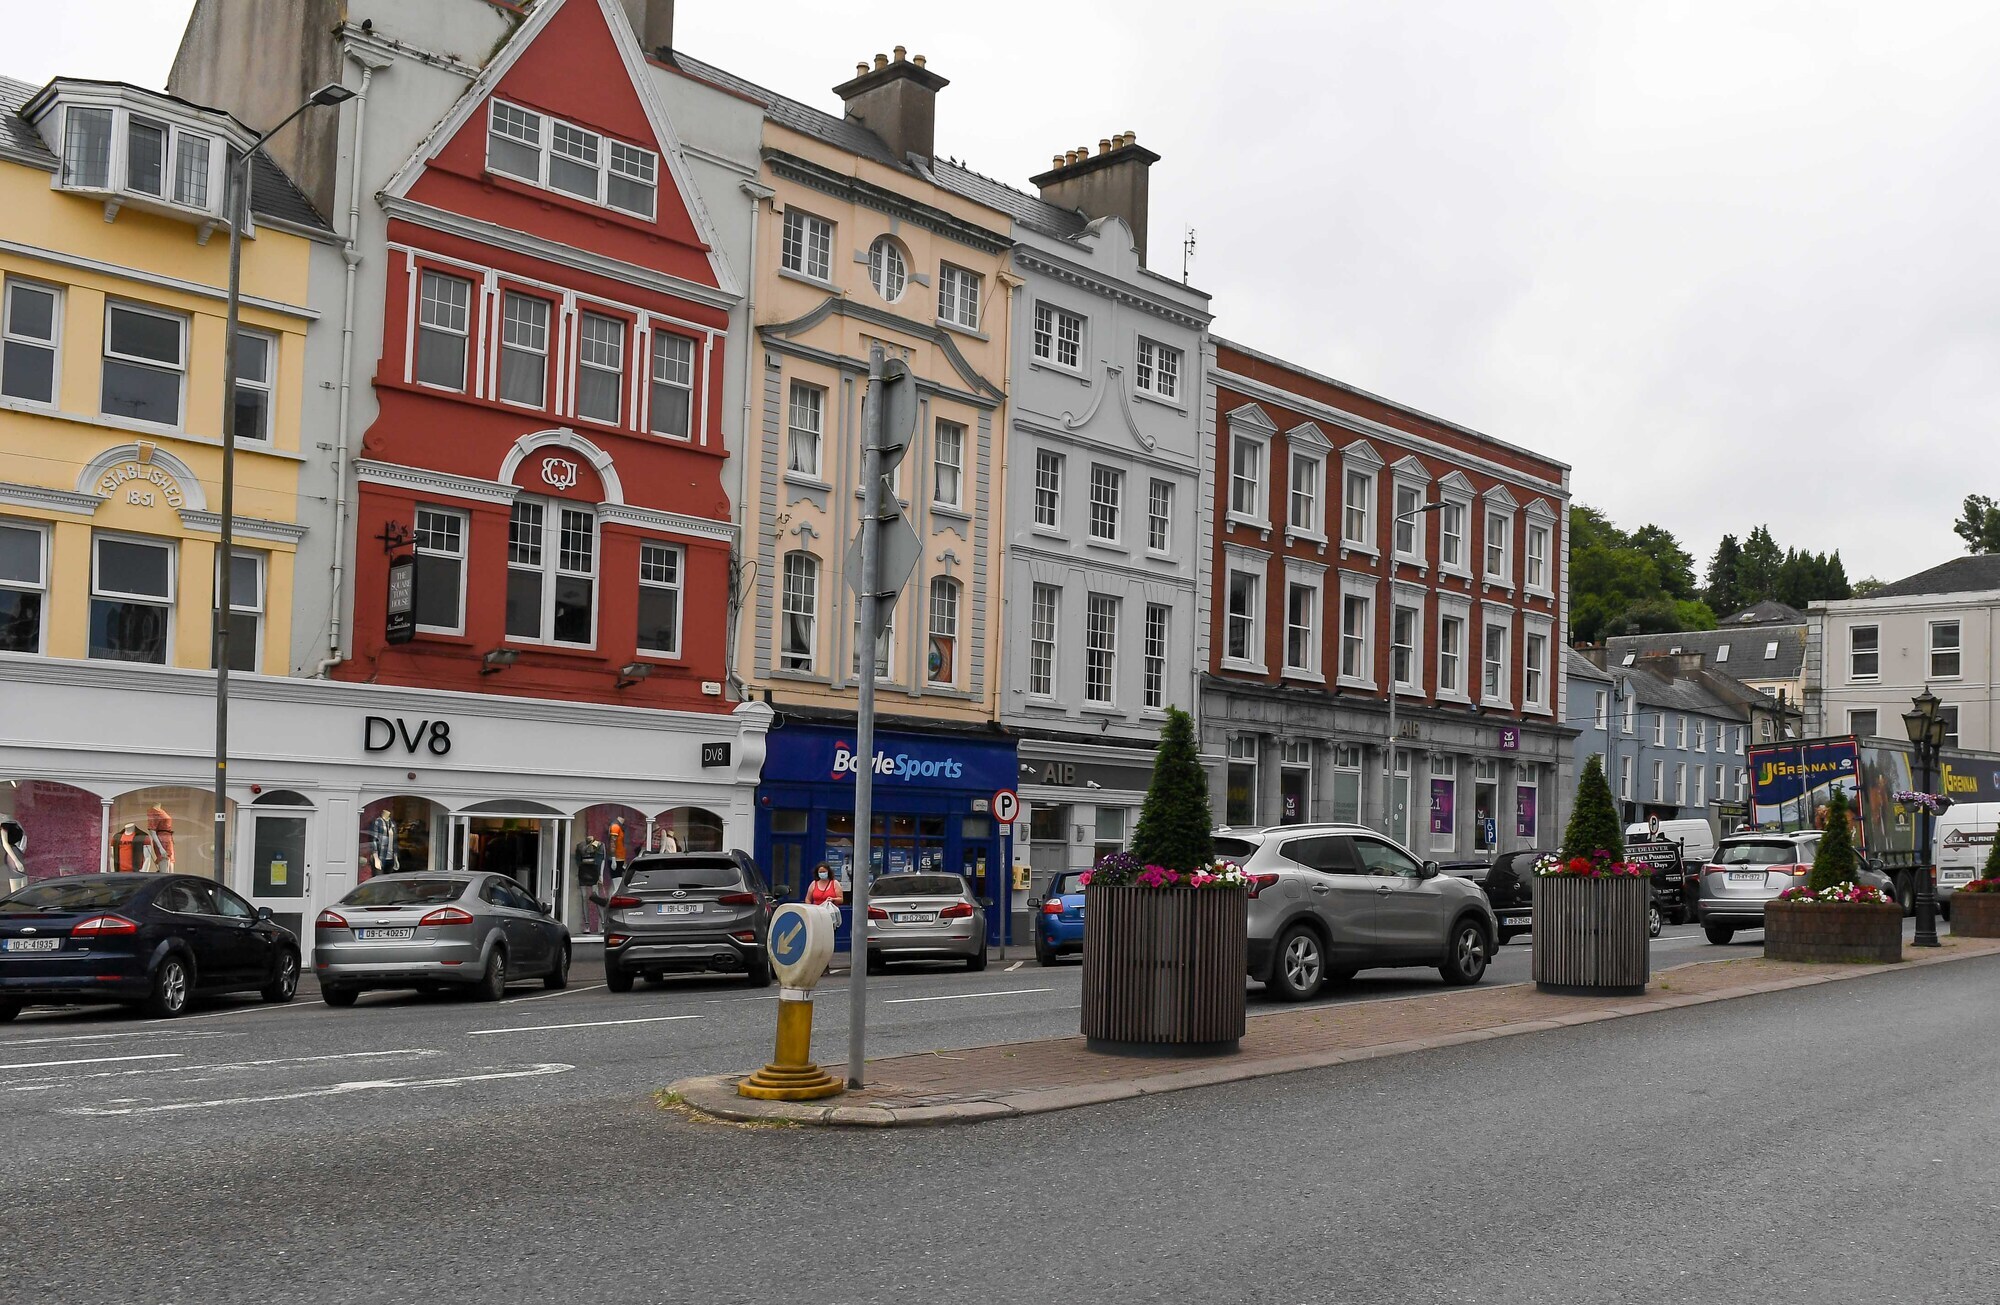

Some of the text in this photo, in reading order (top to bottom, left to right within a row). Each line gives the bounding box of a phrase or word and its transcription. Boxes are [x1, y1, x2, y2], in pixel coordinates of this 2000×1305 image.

[97, 464, 183, 507] ESTABLISHED
[127, 490, 155, 507] 1851
[364, 715, 452, 756] DV8
[1400, 720, 1421, 738] AIB
[704, 747, 723, 762] DV8
[833, 749, 963, 781] BoleSports
[1041, 762, 1076, 785] AIB
[1001, 795, 1012, 817] P
[1488, 831, 1494, 842] P
[1968, 835, 1996, 843] FURNIT
[1637, 845, 1669, 853] DELIVER
[921, 857, 931, 866] €5
[1648, 853, 1674, 861] PHARMACY
[366, 929, 409, 938] 09-C-40257
[12, 940, 54, 950] 10-C-41935
